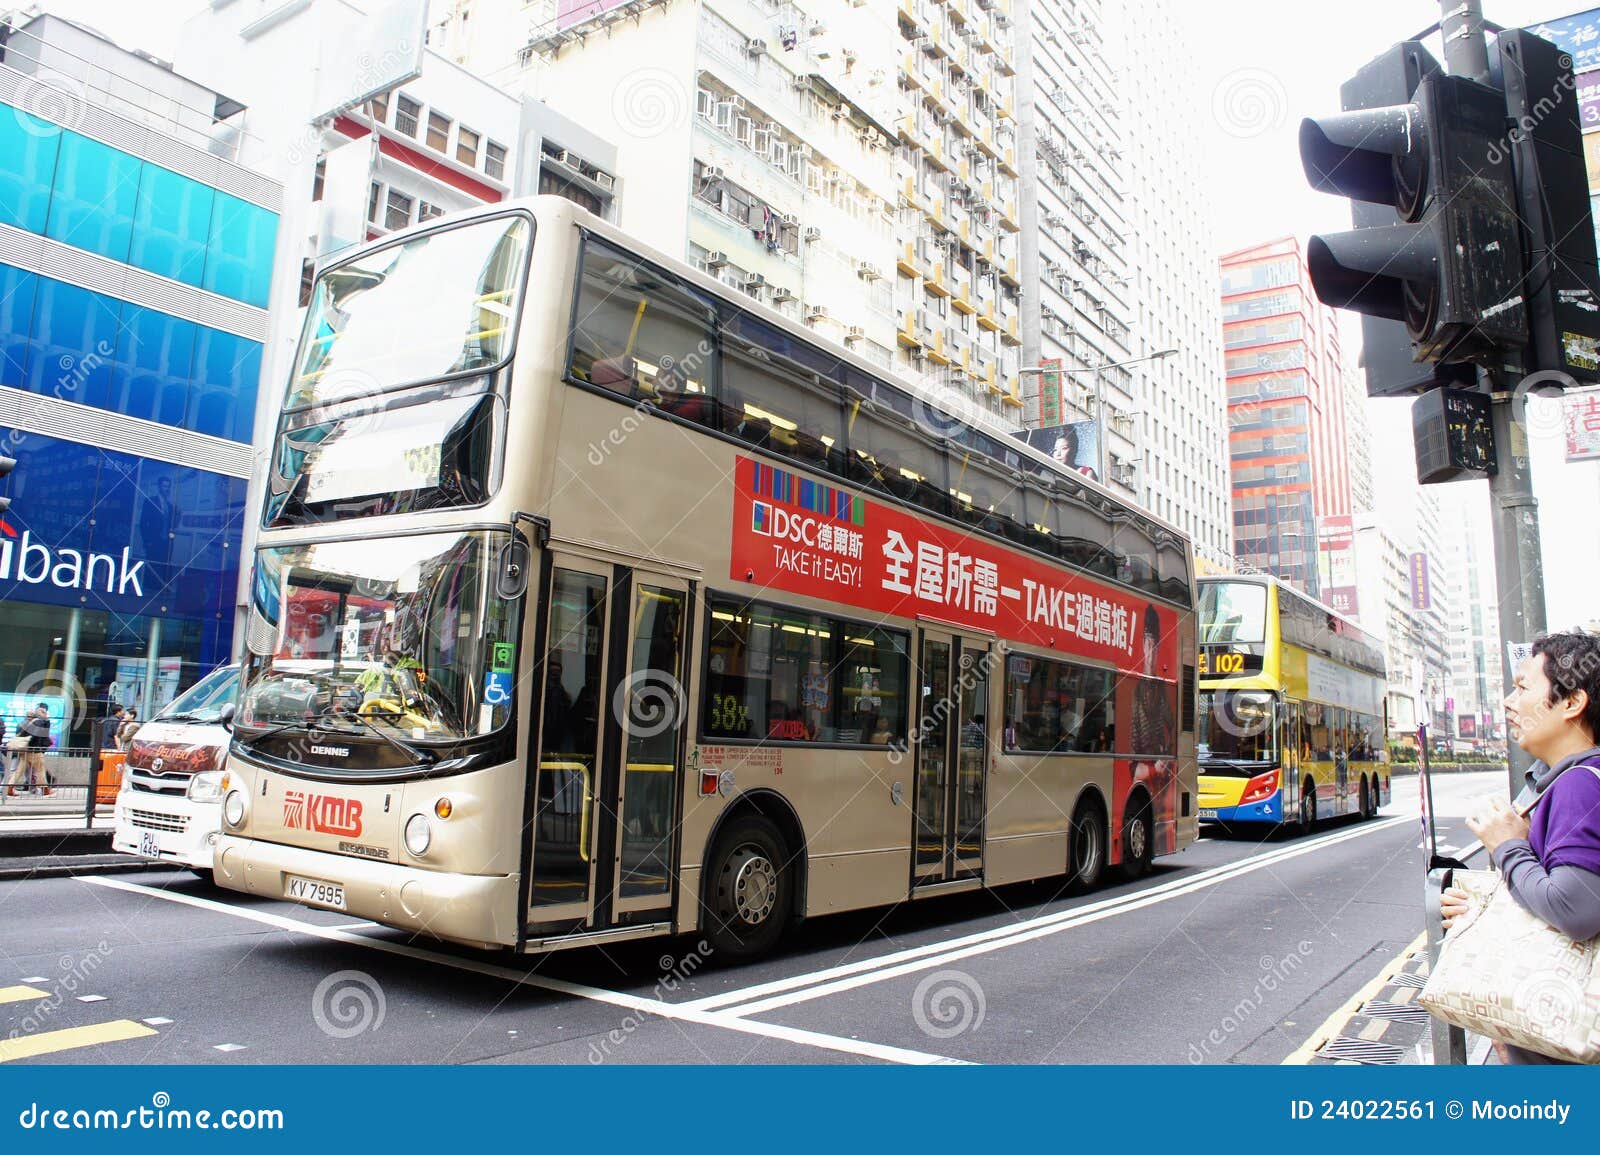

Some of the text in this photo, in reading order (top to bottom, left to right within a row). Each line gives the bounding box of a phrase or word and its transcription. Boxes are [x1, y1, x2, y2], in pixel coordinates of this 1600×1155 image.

[773, 507, 863, 560] DSC 德爾斯
[773, 544, 862, 588] TAKE it EASY!
[1216, 653, 1244, 673] 102
[311, 746, 349, 757] DENNIS
[306, 794, 363, 838] KMB
[139, 842, 159, 858] 1449
[143, 832, 154, 845] PU
[290, 879, 343, 905] KV 7995
